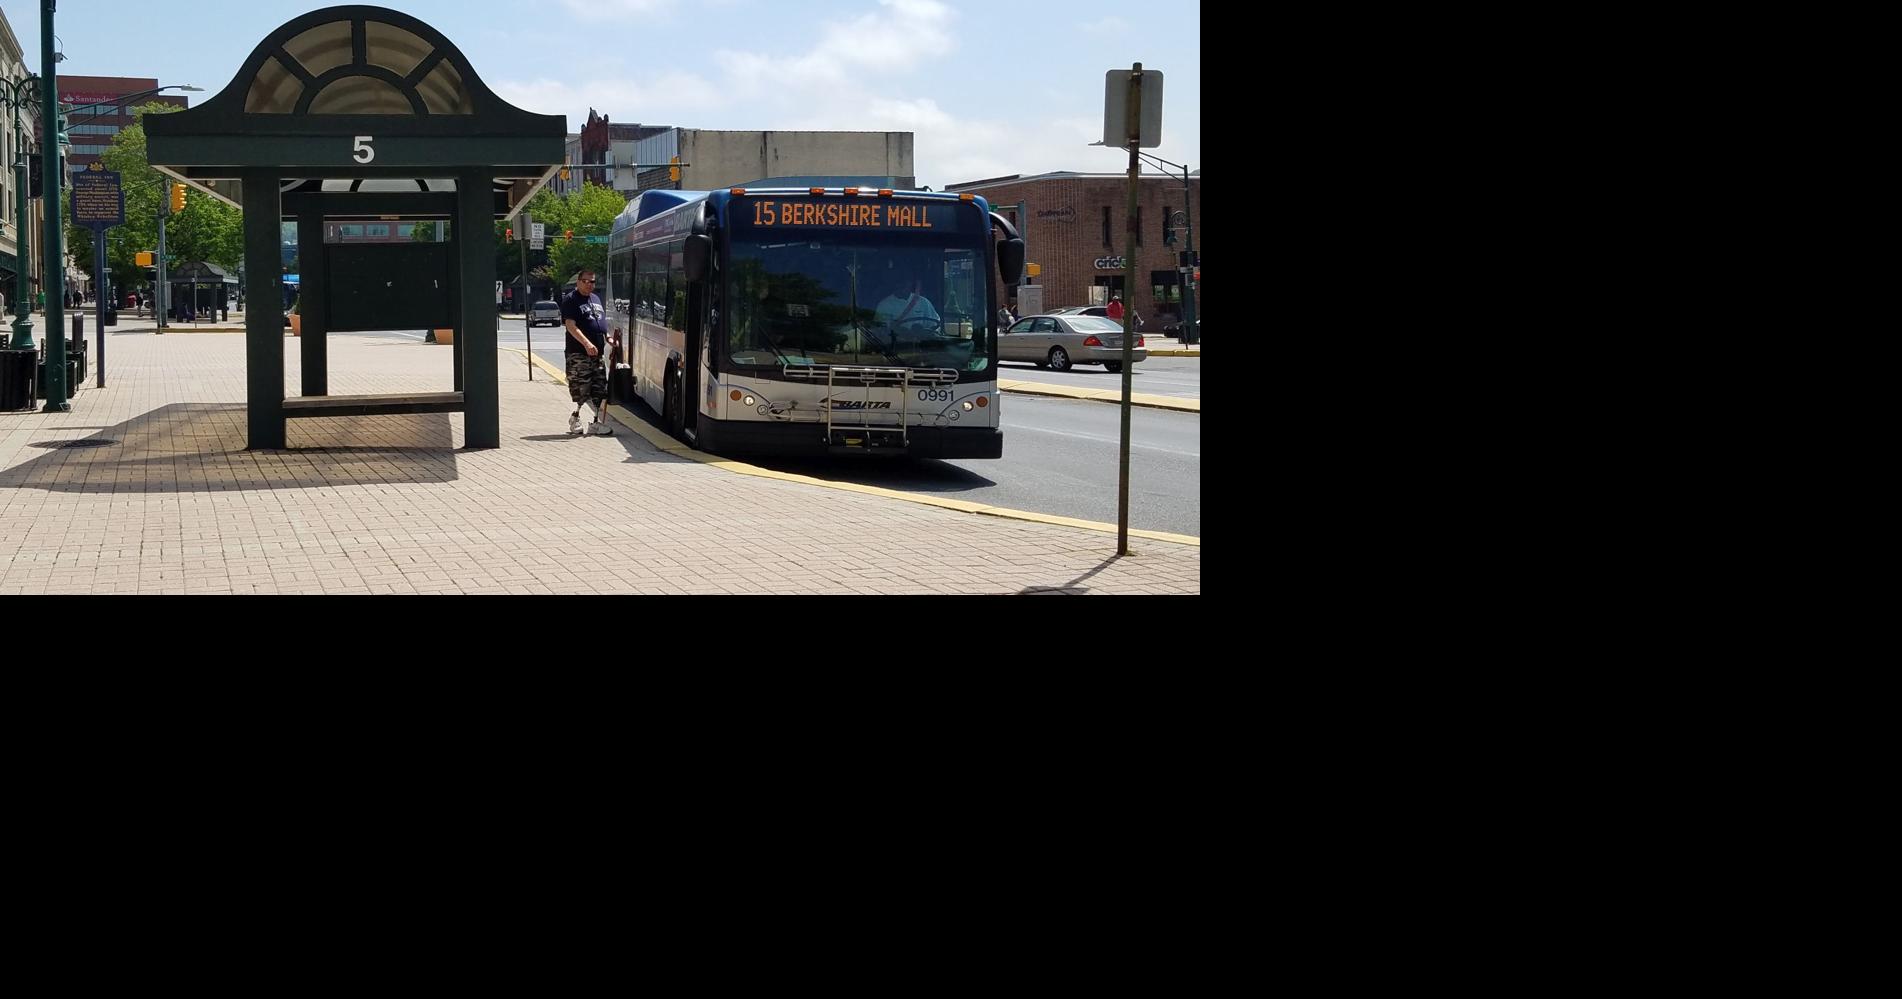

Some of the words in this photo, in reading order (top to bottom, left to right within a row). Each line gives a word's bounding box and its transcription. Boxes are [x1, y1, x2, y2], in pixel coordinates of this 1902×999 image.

[353, 135, 375, 164] 5
[753, 201, 776, 226] 15
[781, 203, 881, 226] BERKSHIRE
[887, 205, 932, 228] MALL
[917, 389, 955, 402] 0991
